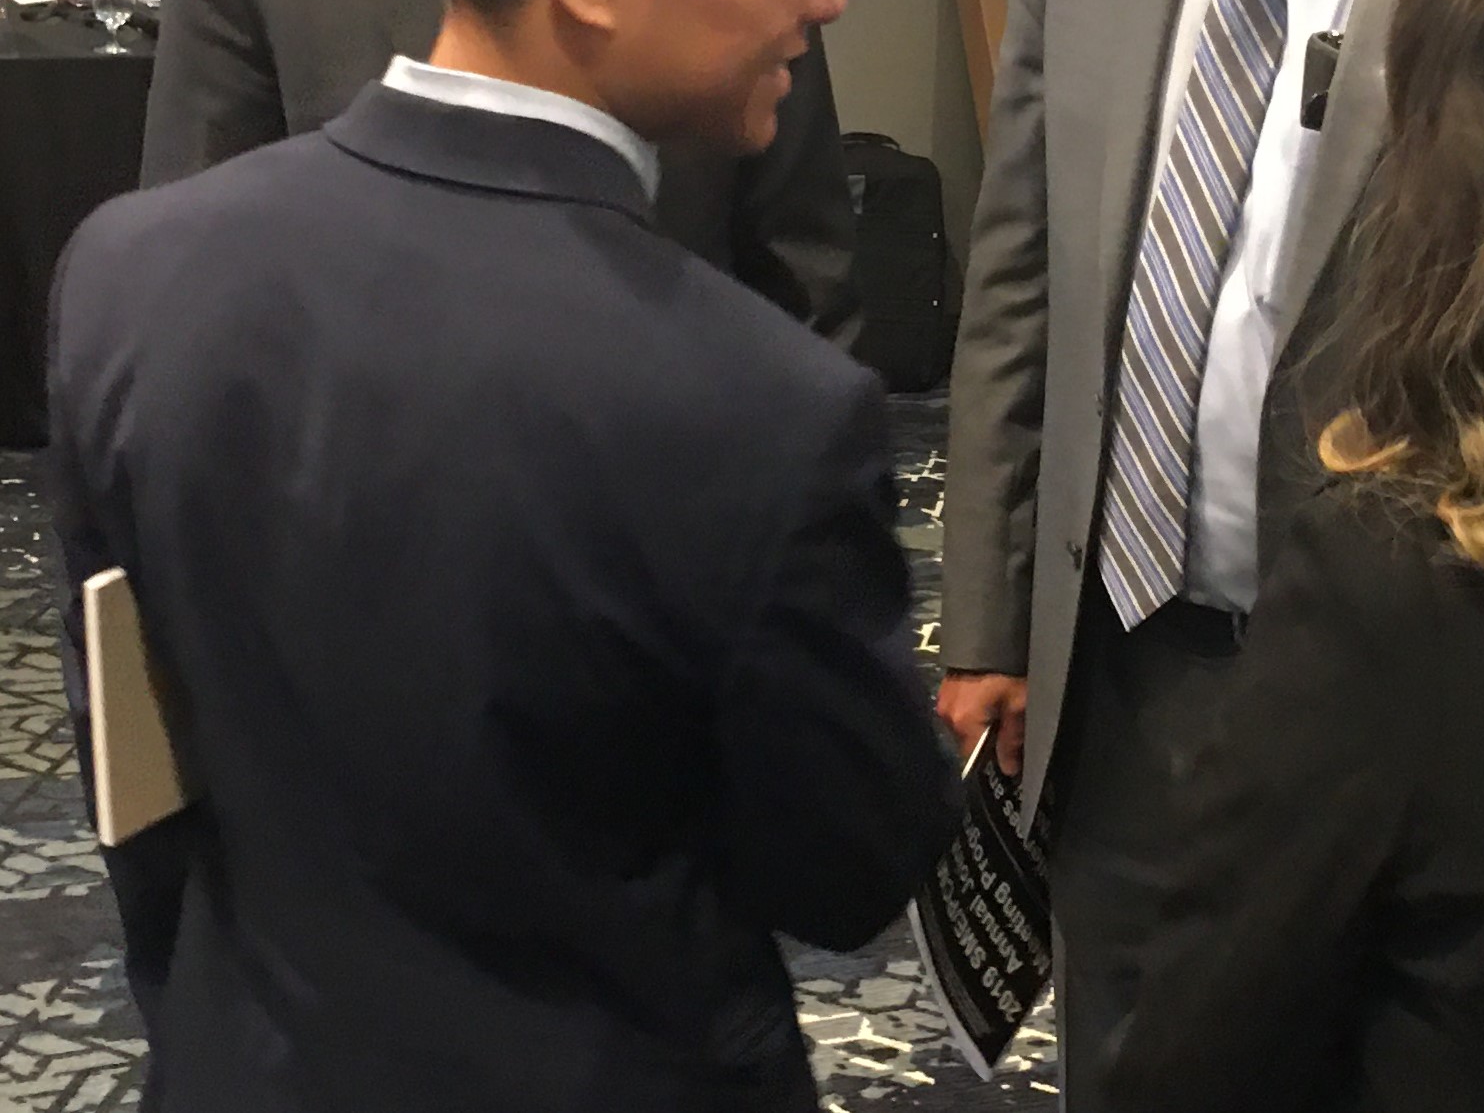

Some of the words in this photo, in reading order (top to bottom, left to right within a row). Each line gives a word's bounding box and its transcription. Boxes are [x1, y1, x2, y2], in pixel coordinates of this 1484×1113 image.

[962, 811, 997, 890] Progra
[970, 894, 1023, 974] Annual
[990, 881, 1051, 976] Meeting
[982, 966, 1022, 1022] 2019
